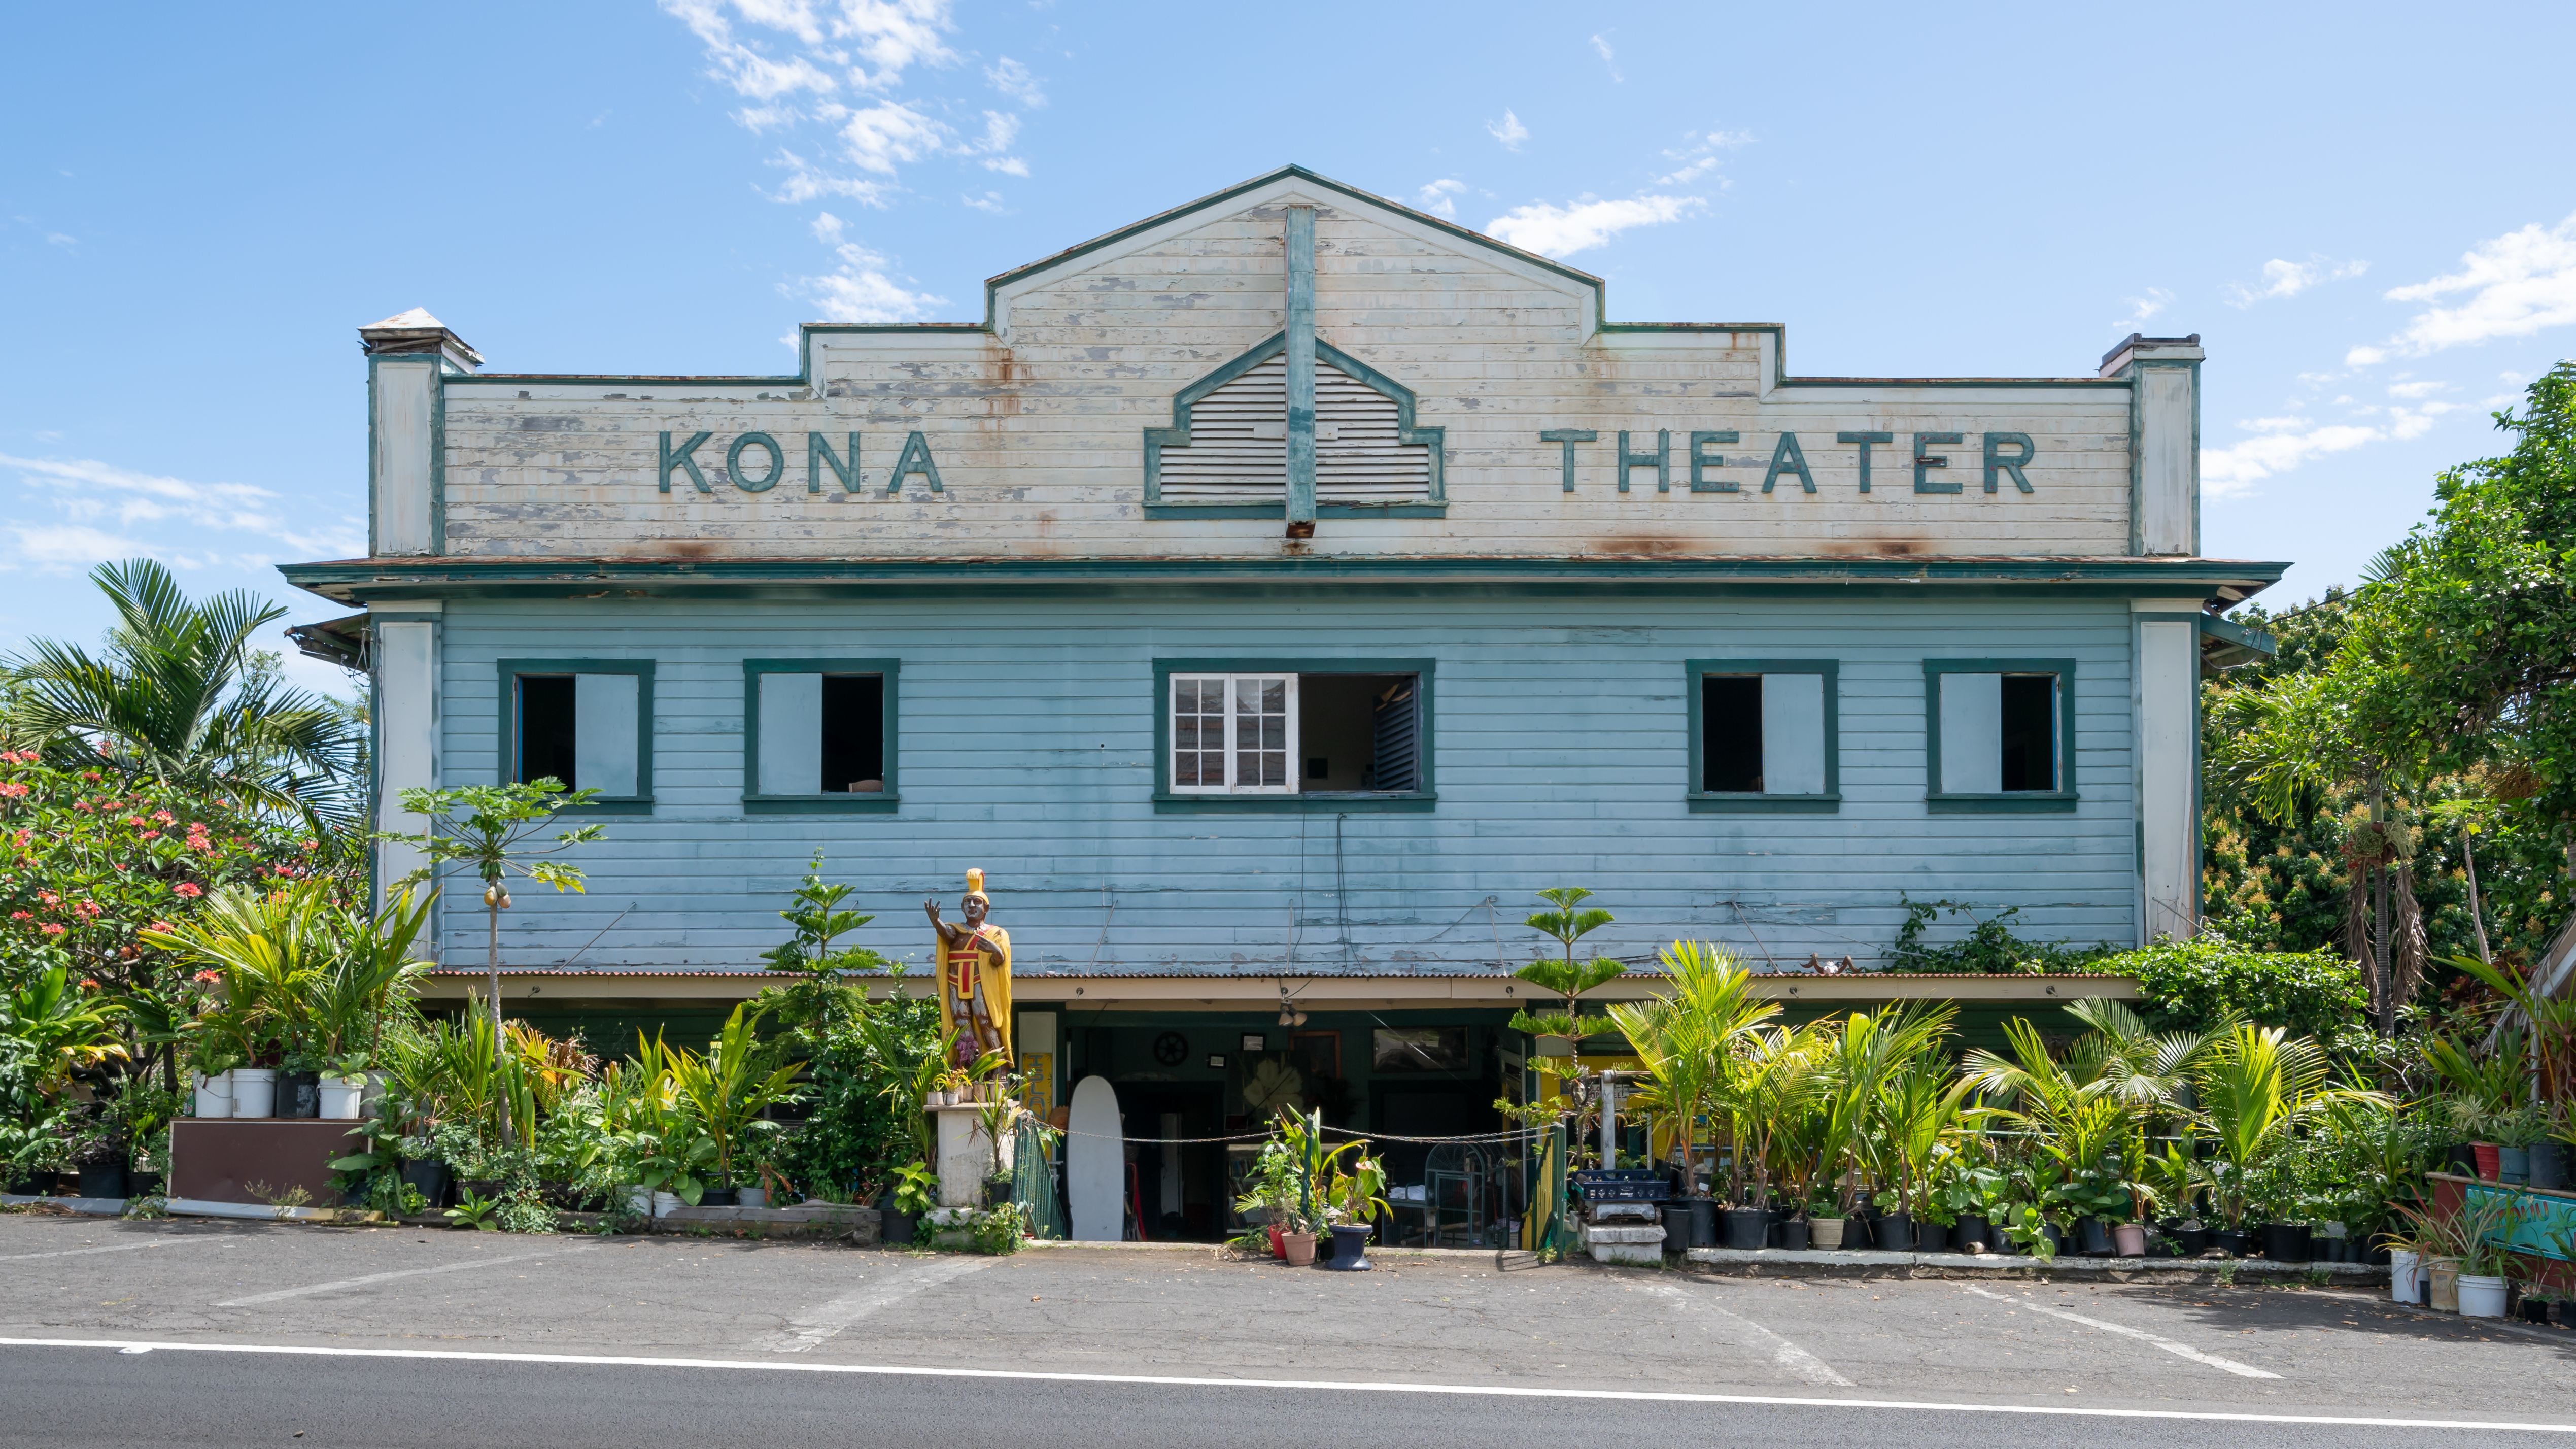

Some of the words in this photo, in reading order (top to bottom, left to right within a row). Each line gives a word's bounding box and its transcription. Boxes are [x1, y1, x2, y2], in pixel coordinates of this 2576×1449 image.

[659, 430, 944, 493] KONA
[1540, 428, 2035, 494] THEATER
[1027, 1054, 1047, 1128] ISLAN
